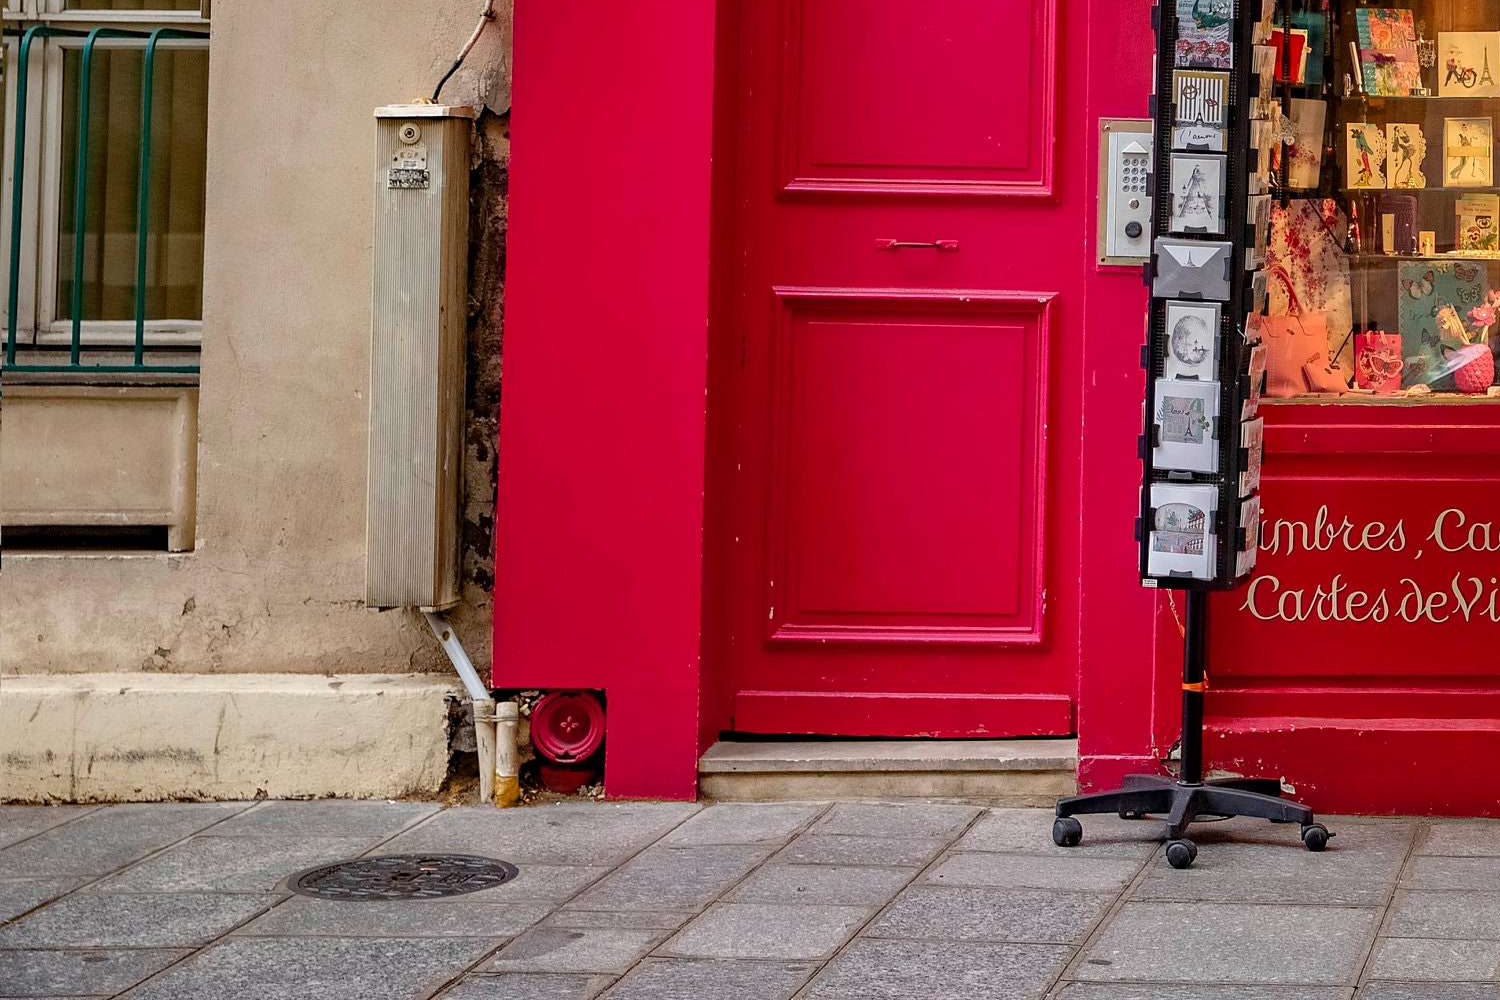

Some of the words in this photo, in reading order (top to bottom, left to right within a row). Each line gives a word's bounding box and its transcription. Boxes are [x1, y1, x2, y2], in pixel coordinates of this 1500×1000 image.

[1260, 504, 1424, 560] imbres,
[1239, 574, 1390, 623] Cartes
[1394, 578, 1450, 624] de
